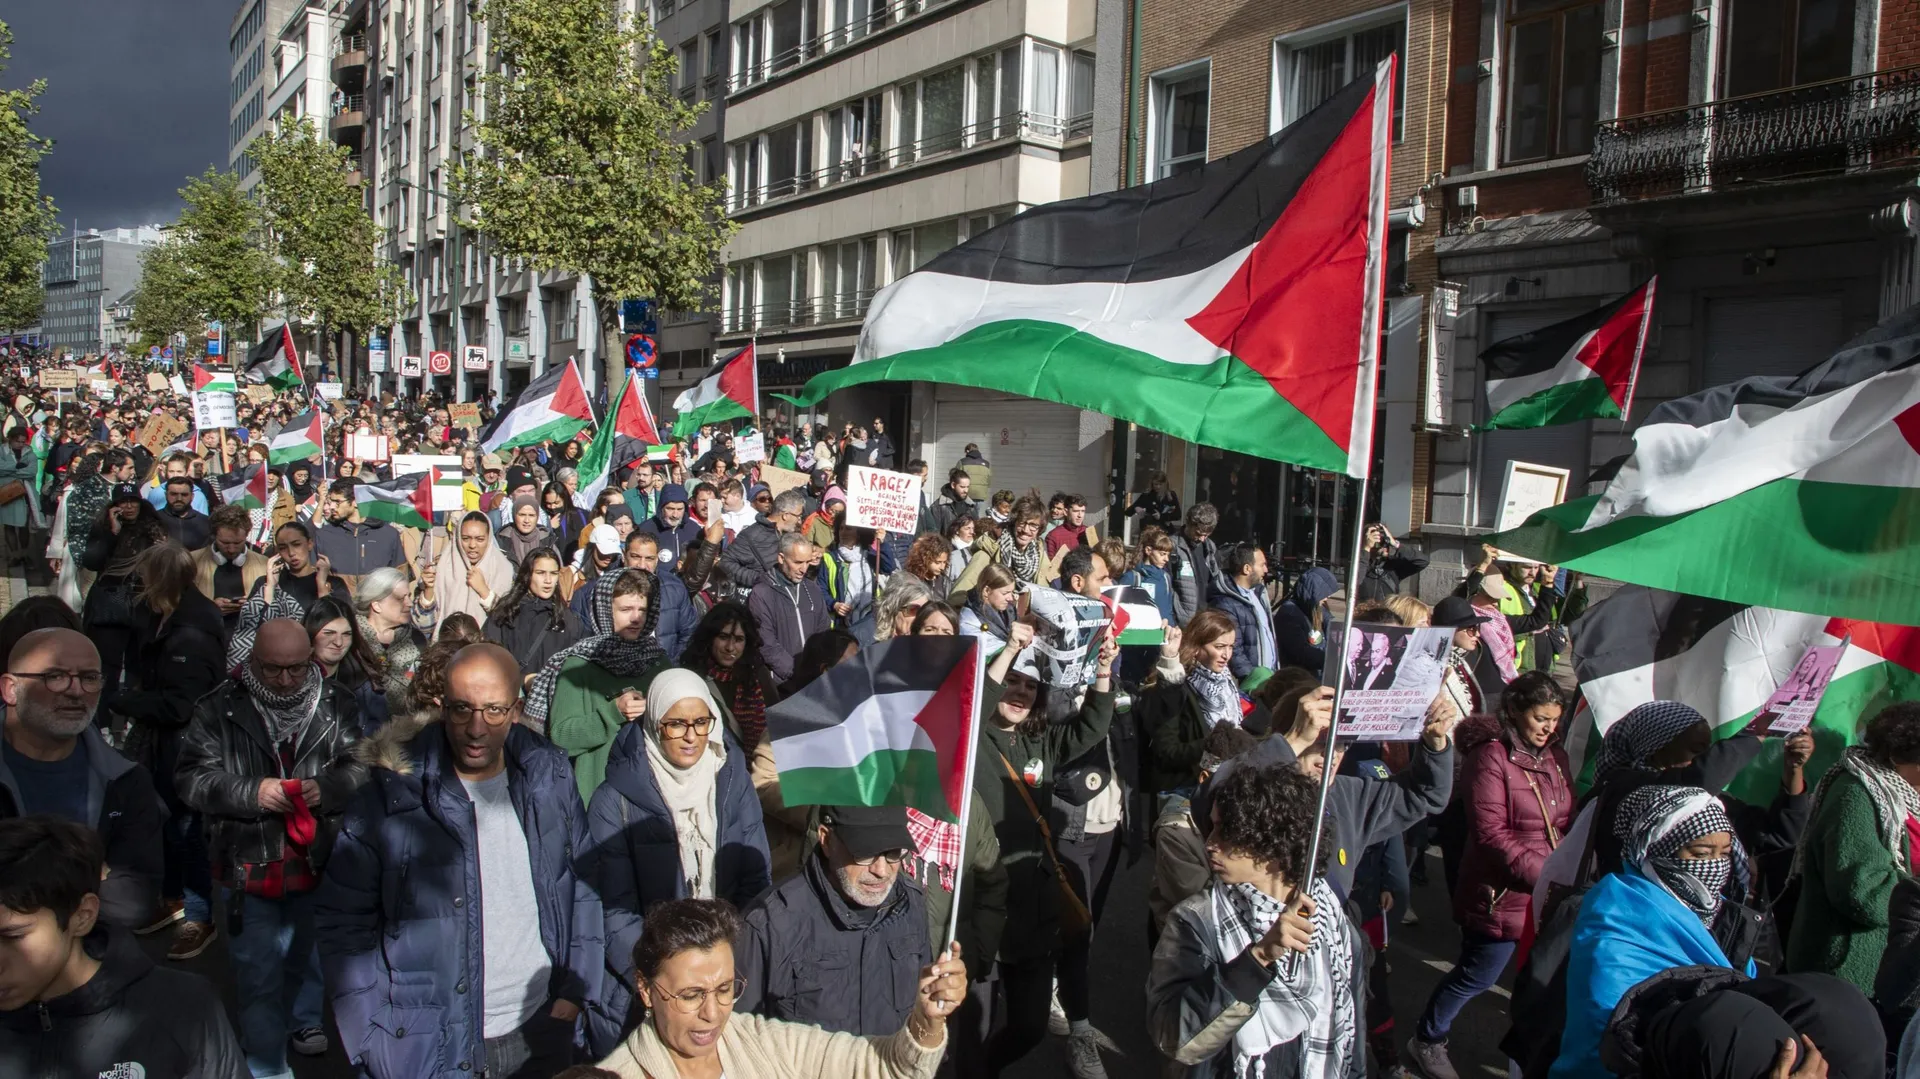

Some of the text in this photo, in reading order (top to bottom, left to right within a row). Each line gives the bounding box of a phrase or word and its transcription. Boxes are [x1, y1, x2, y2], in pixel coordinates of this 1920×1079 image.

[1433, 341, 1448, 420] périple
[877, 492, 907, 504] AGAINST
[870, 516, 915, 533] SUPREMACY
[1369, 723, 1399, 731] MASSACRES
[113, 1062, 130, 1071] THE
[99, 1069, 129, 1079] NORTH
